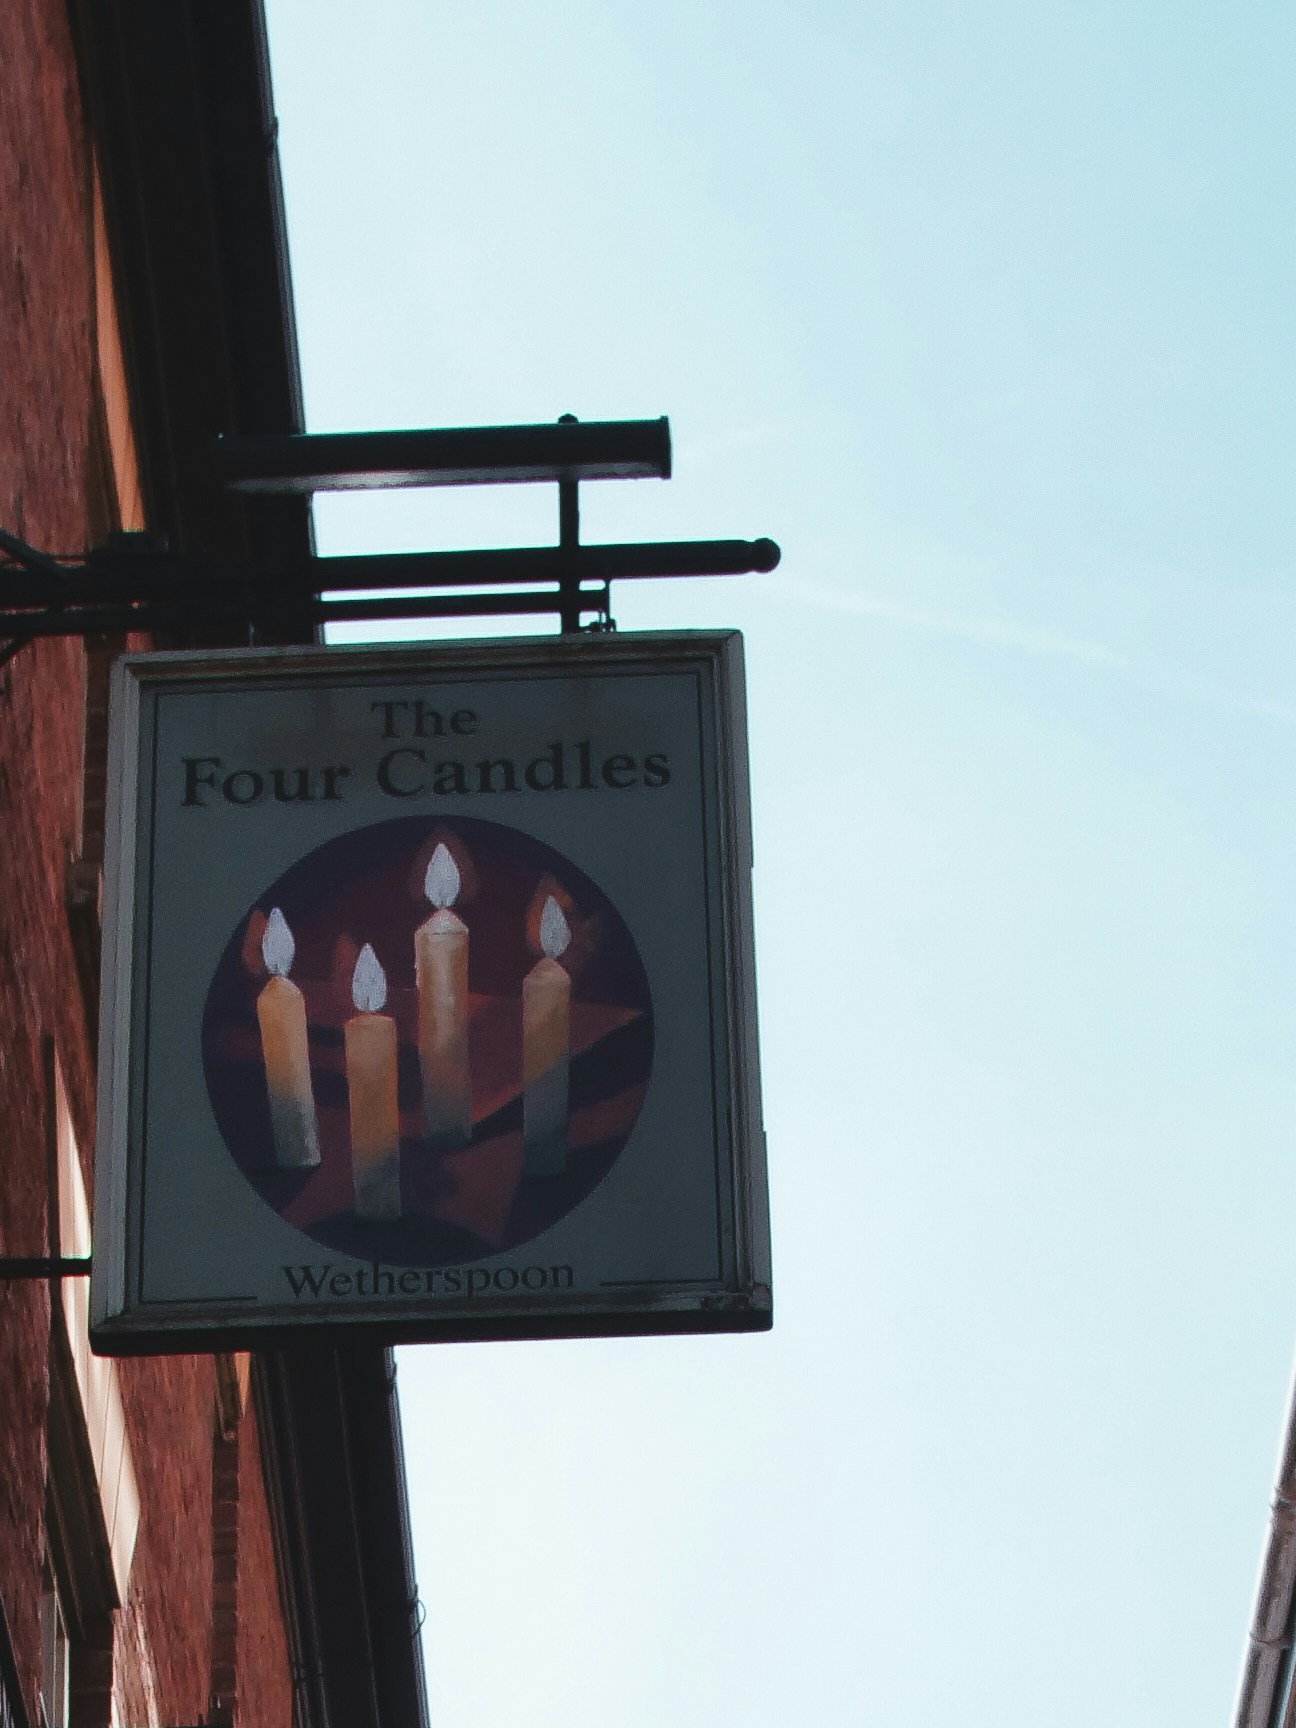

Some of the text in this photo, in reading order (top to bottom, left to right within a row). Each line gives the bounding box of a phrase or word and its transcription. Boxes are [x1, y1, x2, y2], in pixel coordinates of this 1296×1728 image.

[370, 698, 479, 741] The
[181, 740, 672, 807] Four Candles
[282, 1262, 575, 1300] Wetherspoon
